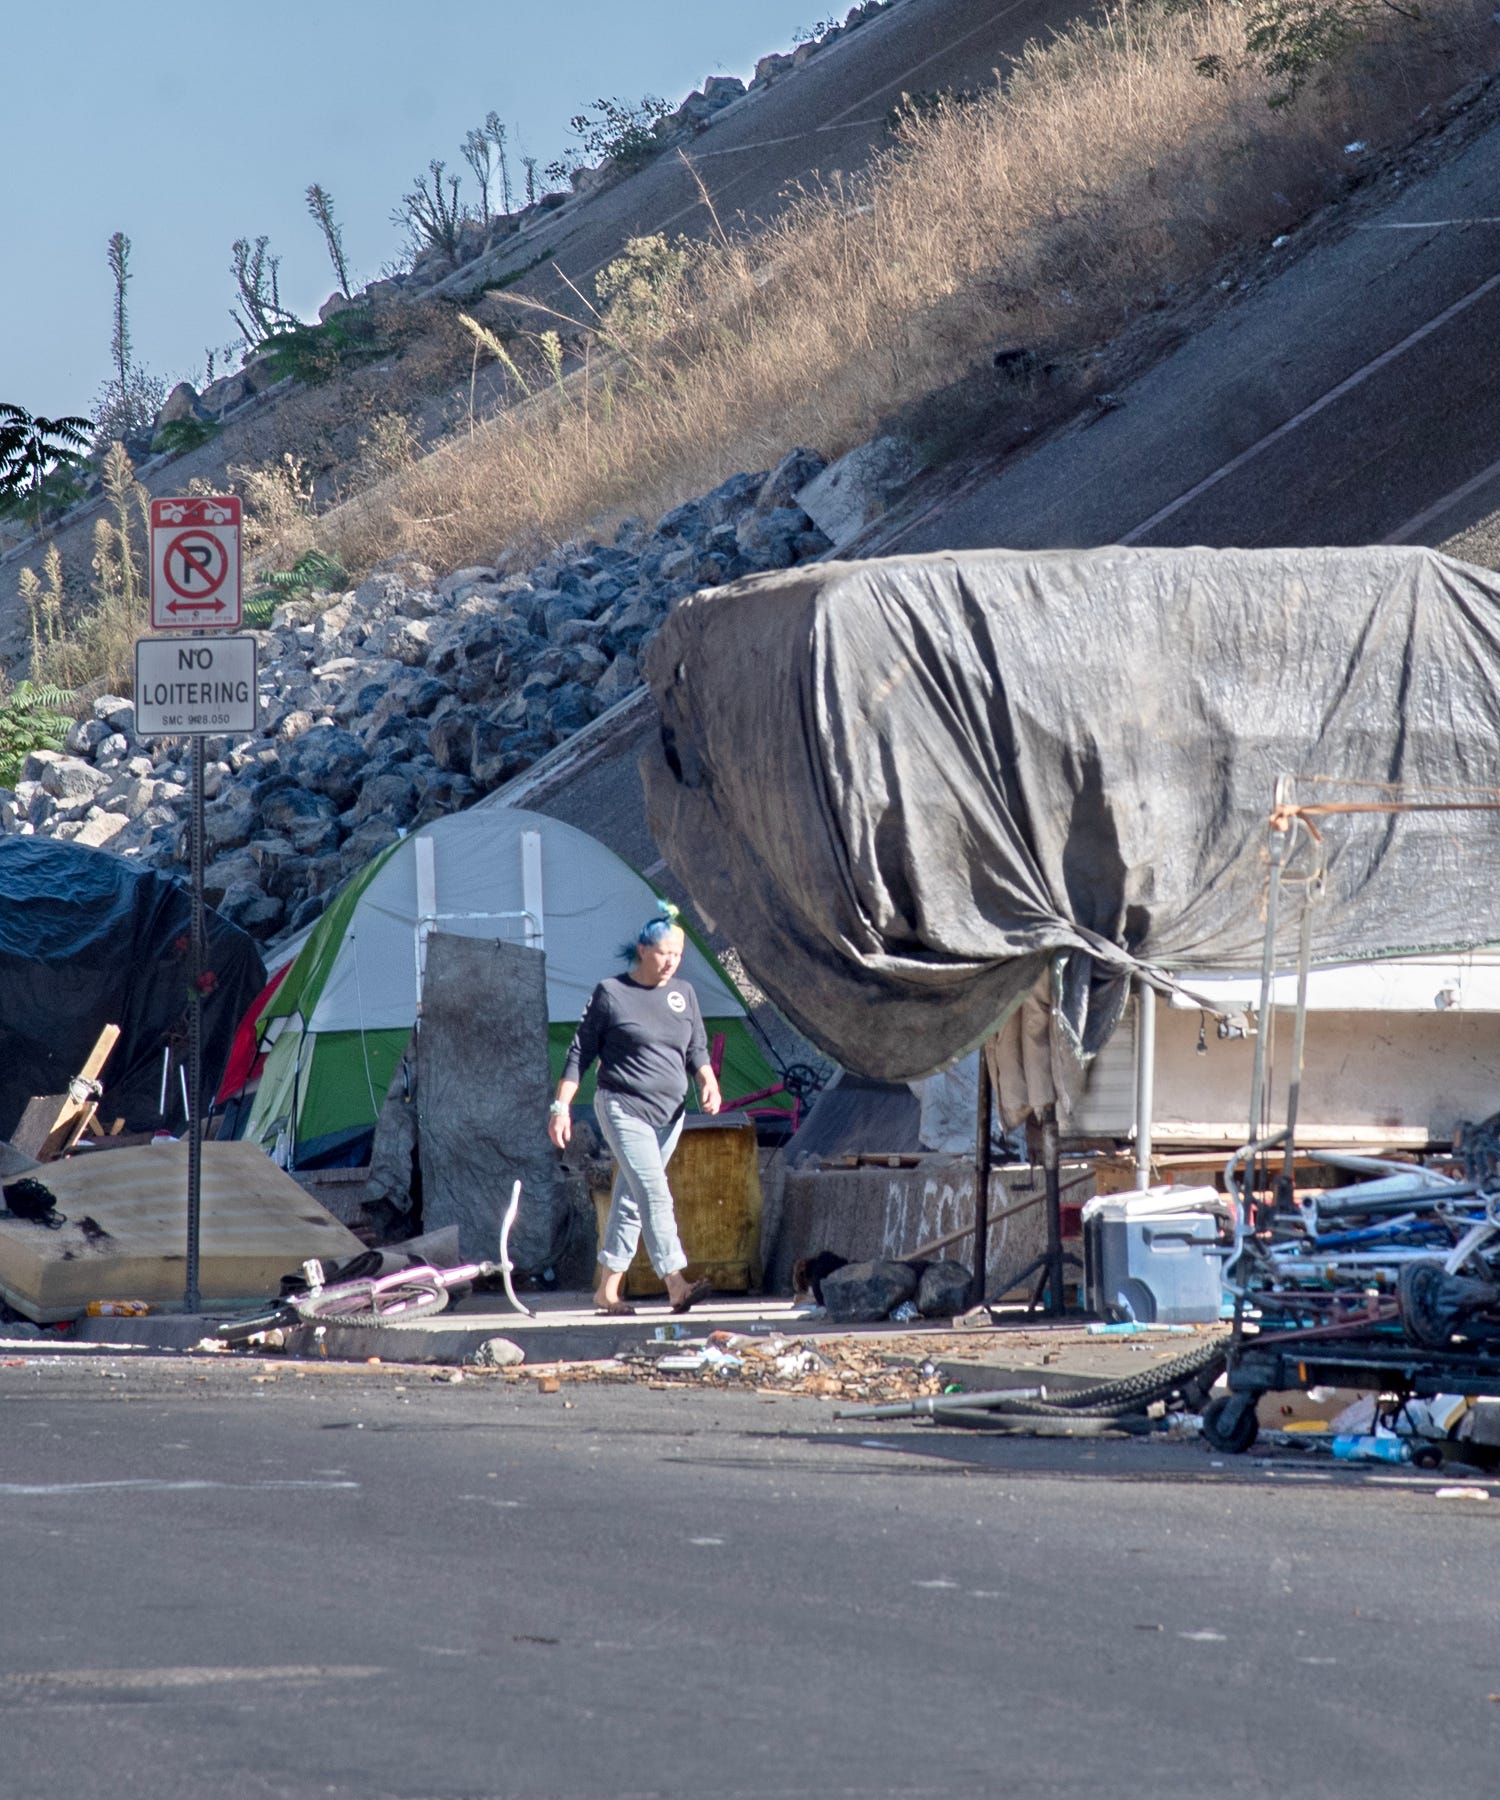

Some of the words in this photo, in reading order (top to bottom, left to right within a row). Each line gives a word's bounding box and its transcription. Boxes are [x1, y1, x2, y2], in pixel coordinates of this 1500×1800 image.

[184, 545, 212, 584] P
[178, 647, 213, 670] NO
[143, 681, 249, 706] LOITERING
[162, 714, 184, 726] SMC
[188, 714, 231, 726] 928.050
